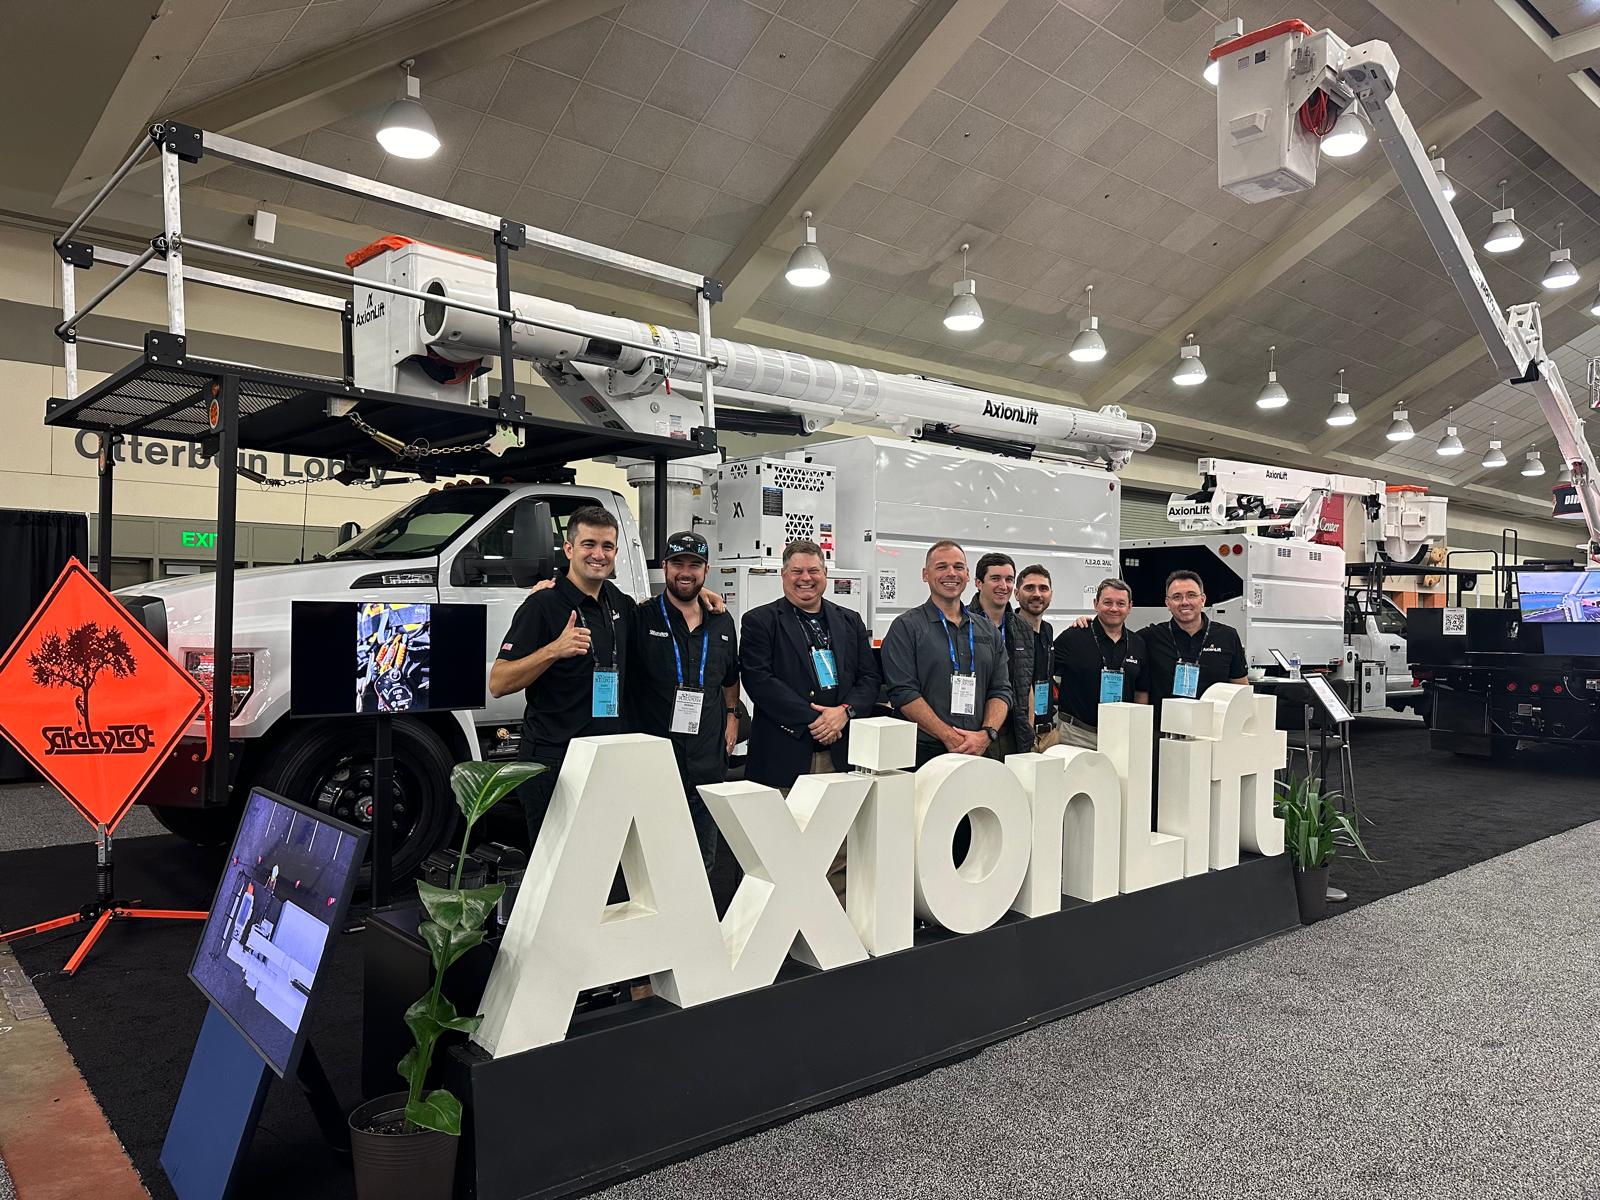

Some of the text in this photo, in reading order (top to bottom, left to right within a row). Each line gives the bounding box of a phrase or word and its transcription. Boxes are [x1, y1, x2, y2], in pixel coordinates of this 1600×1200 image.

[356, 302, 385, 327] AxionLift
[982, 400, 1038, 425] AxionLift
[74, 428, 387, 488] Otterbin Loby
[1168, 505, 1210, 516] AxionLift
[182, 531, 218, 548] EXI
[471, 683, 1287, 1059] AxionLift
